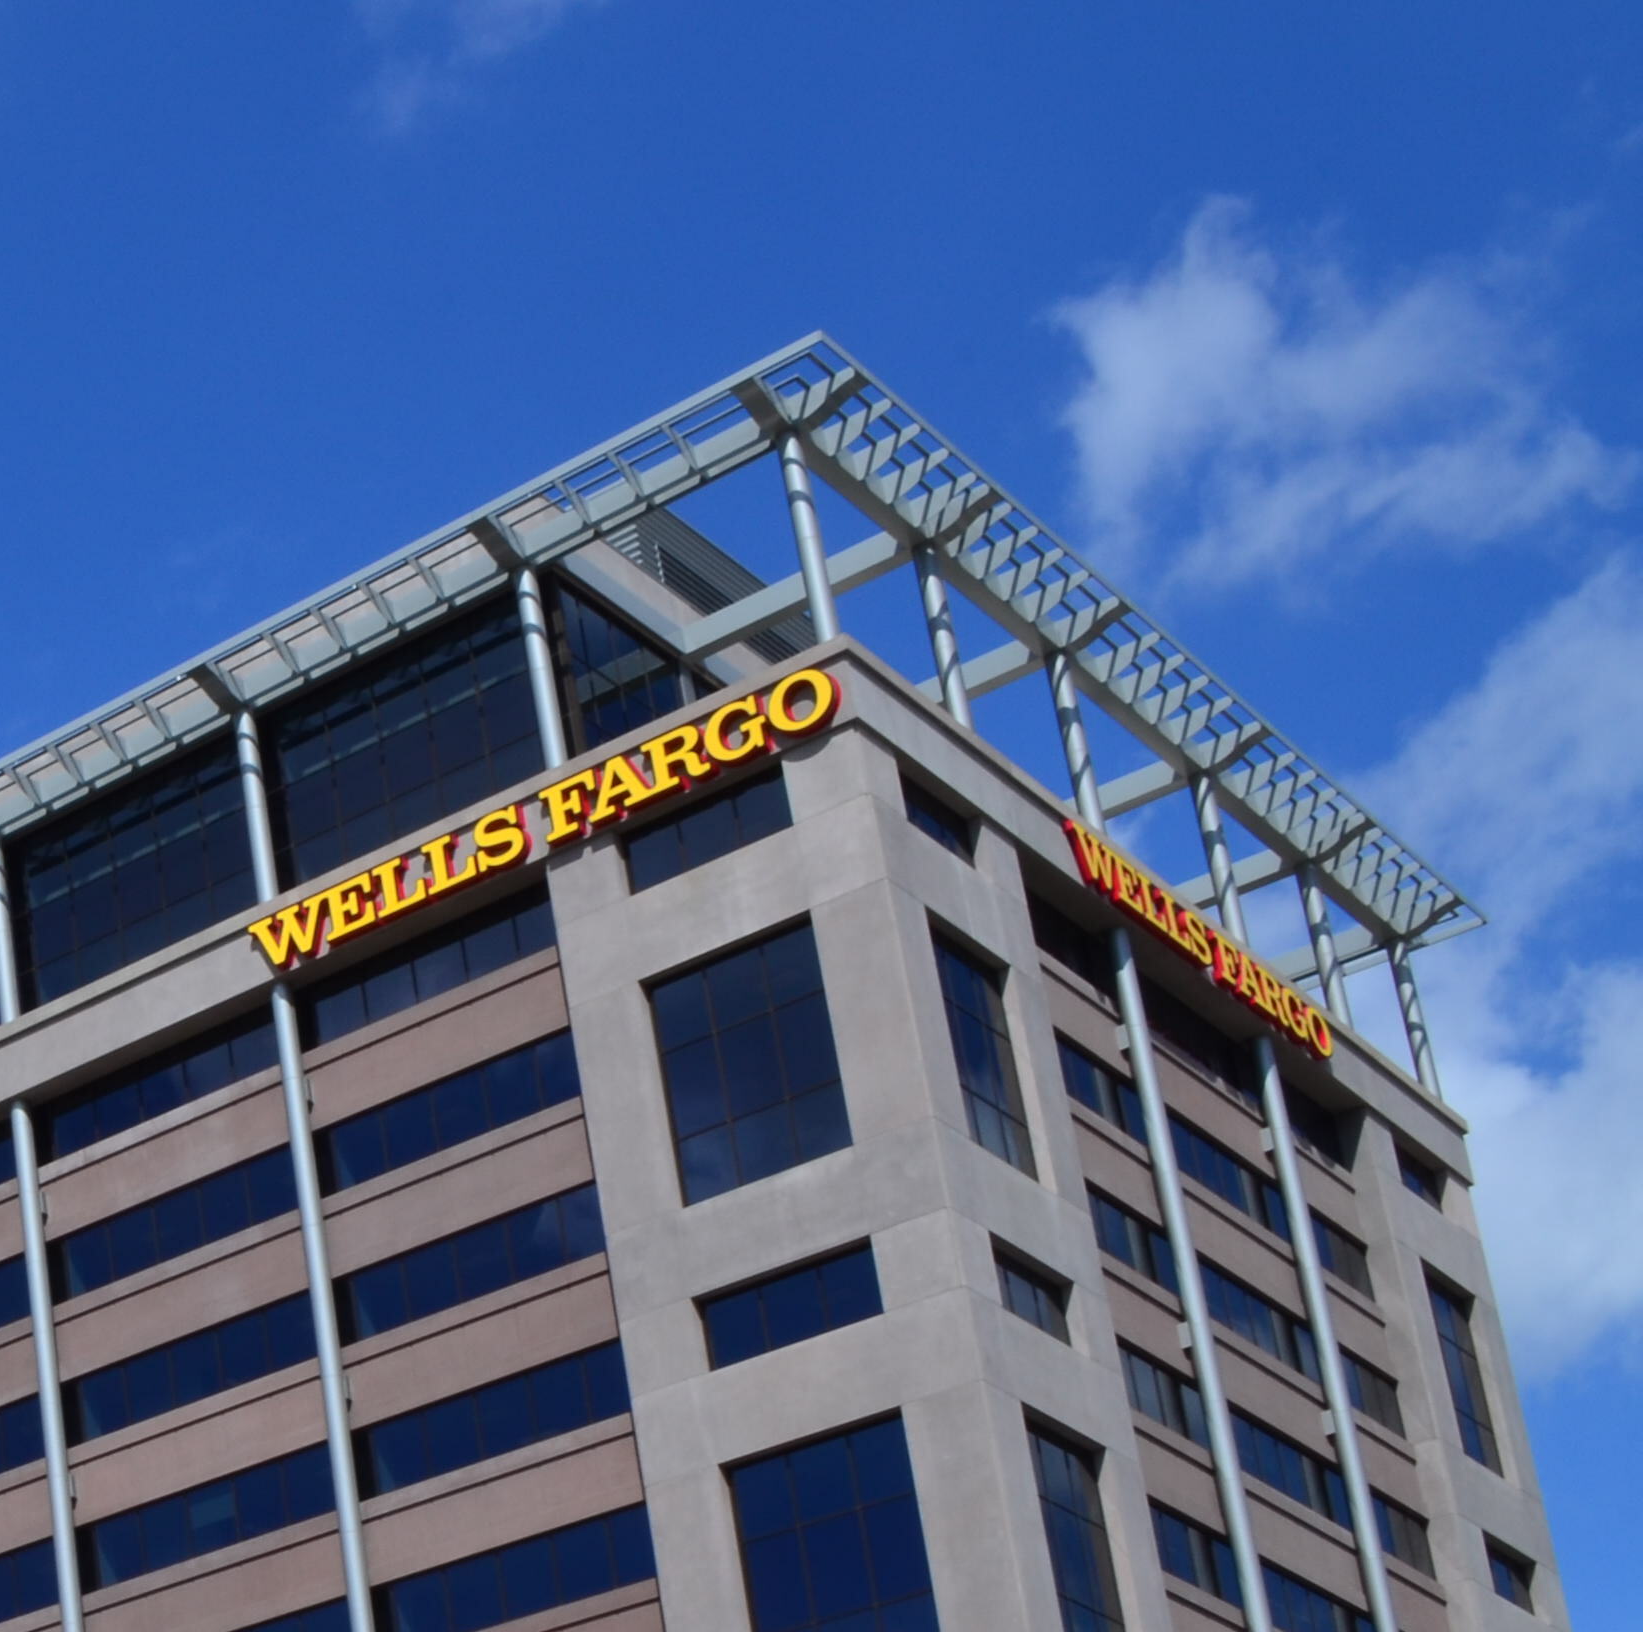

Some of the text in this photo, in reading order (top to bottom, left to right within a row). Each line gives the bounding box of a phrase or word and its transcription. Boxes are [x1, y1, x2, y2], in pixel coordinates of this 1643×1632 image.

[248, 669, 842, 970] WELLS FARGO
[1062, 819, 1333, 1061] WELLS FARGO
